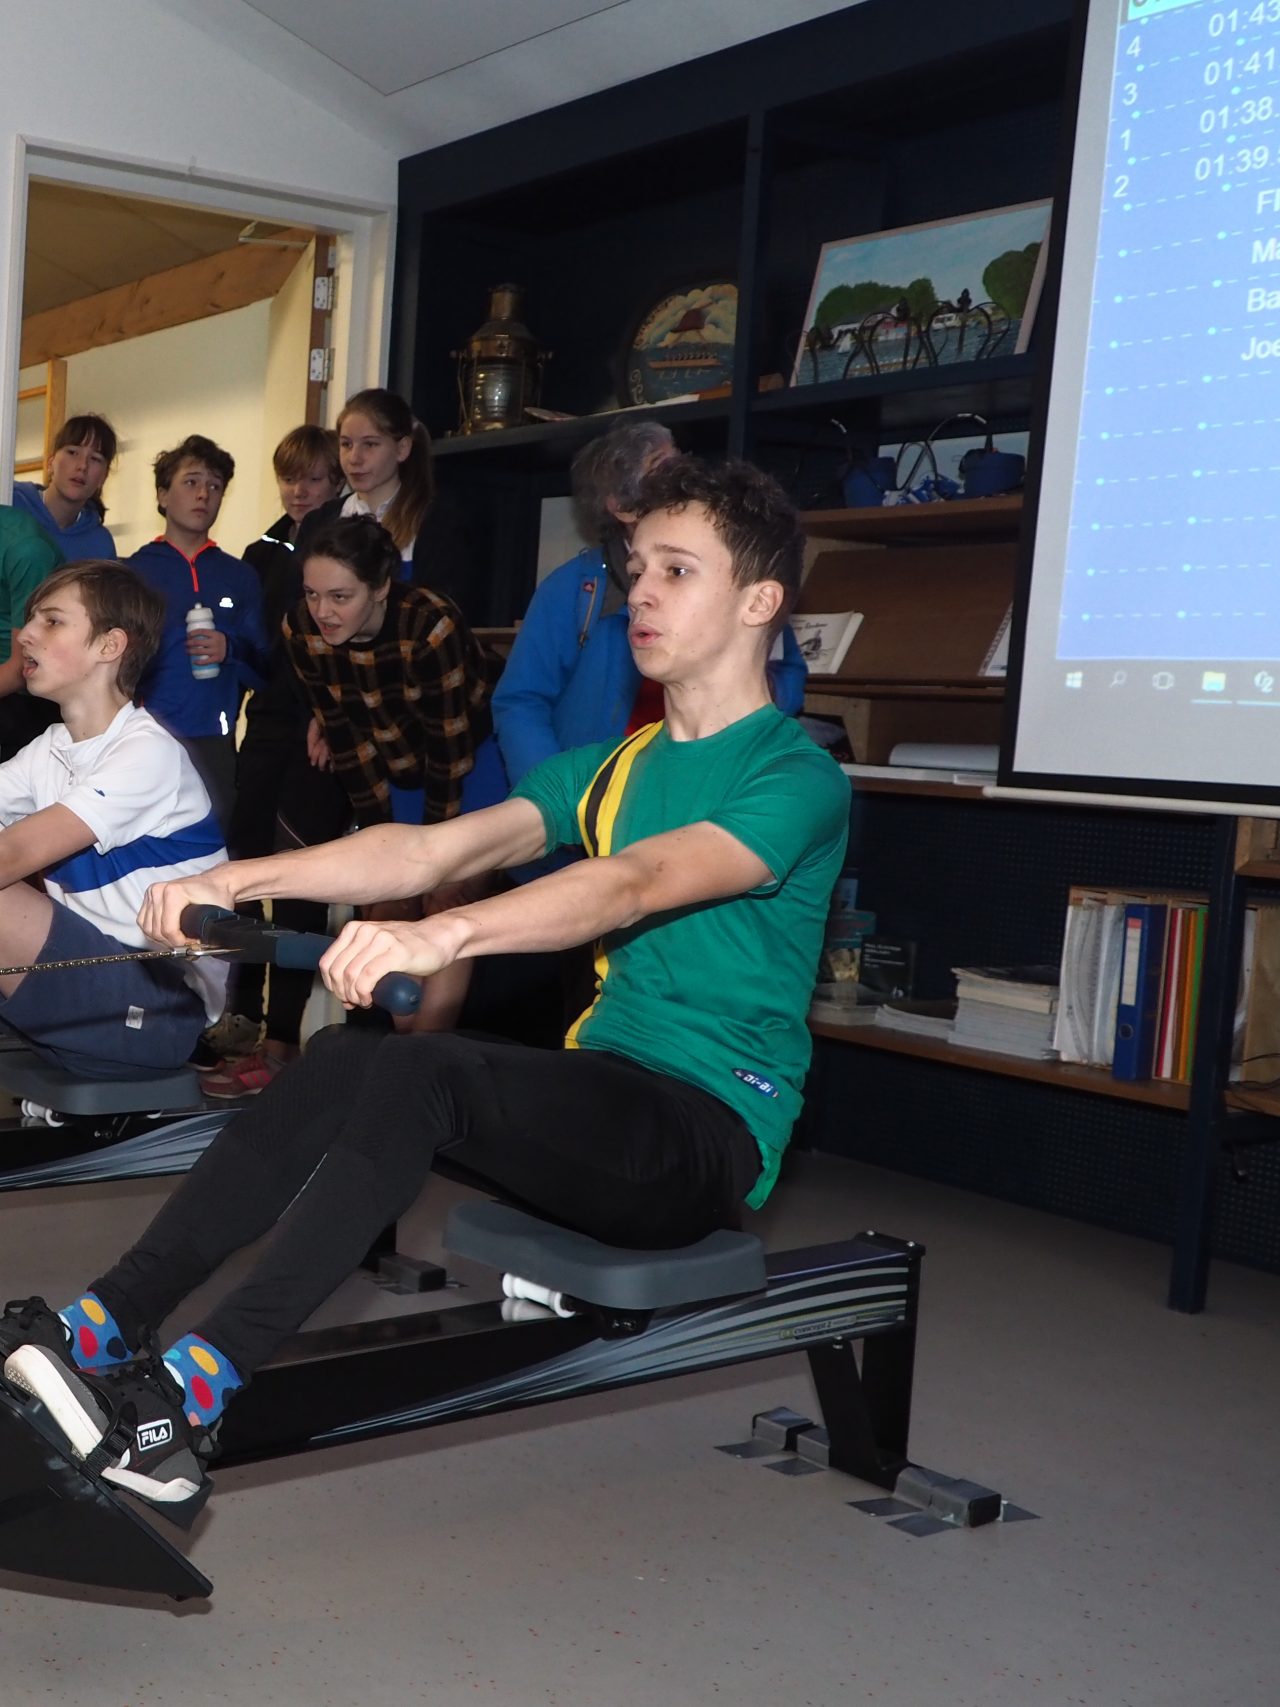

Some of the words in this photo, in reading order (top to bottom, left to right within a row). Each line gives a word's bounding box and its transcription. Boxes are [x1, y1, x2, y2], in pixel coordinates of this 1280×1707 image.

[1125, 35, 1142, 59] 4
[1122, 82, 1139, 106] 3
[1120, 128, 1131, 151] 1
[1113, 175, 1130, 198] 2
[1195, 145, 1280, 181] 01:39.
[141, 1426, 168, 1446] FILA
